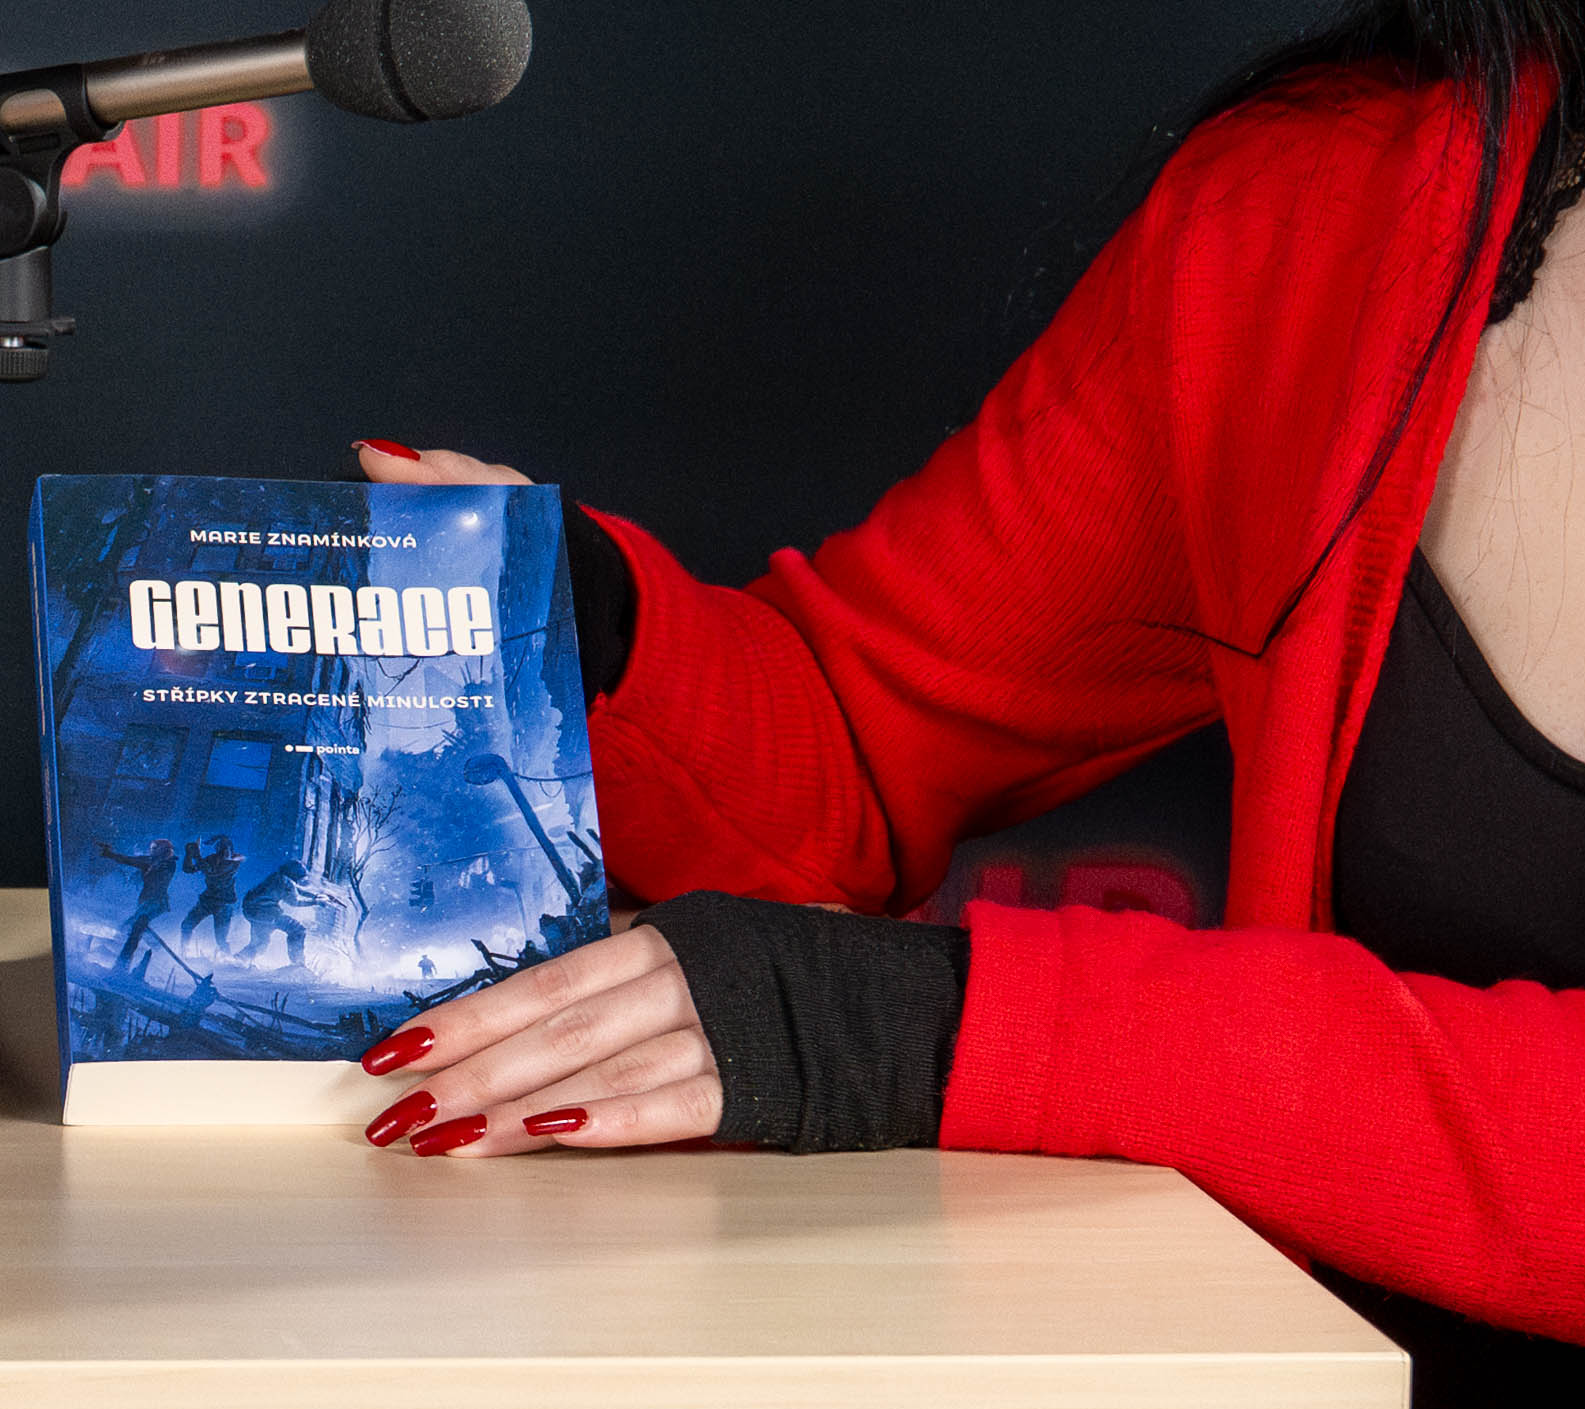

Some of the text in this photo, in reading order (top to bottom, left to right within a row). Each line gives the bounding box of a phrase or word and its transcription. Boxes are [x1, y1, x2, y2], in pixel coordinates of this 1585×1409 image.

[61, 103, 269, 187] AIR
[190, 529, 418, 549] MARIE ZNAMÍNKOVÁ
[142, 686, 494, 710] STŘÍPKY ZTRACENÉ MINULOSTI
[316, 743, 360, 756] pointa
